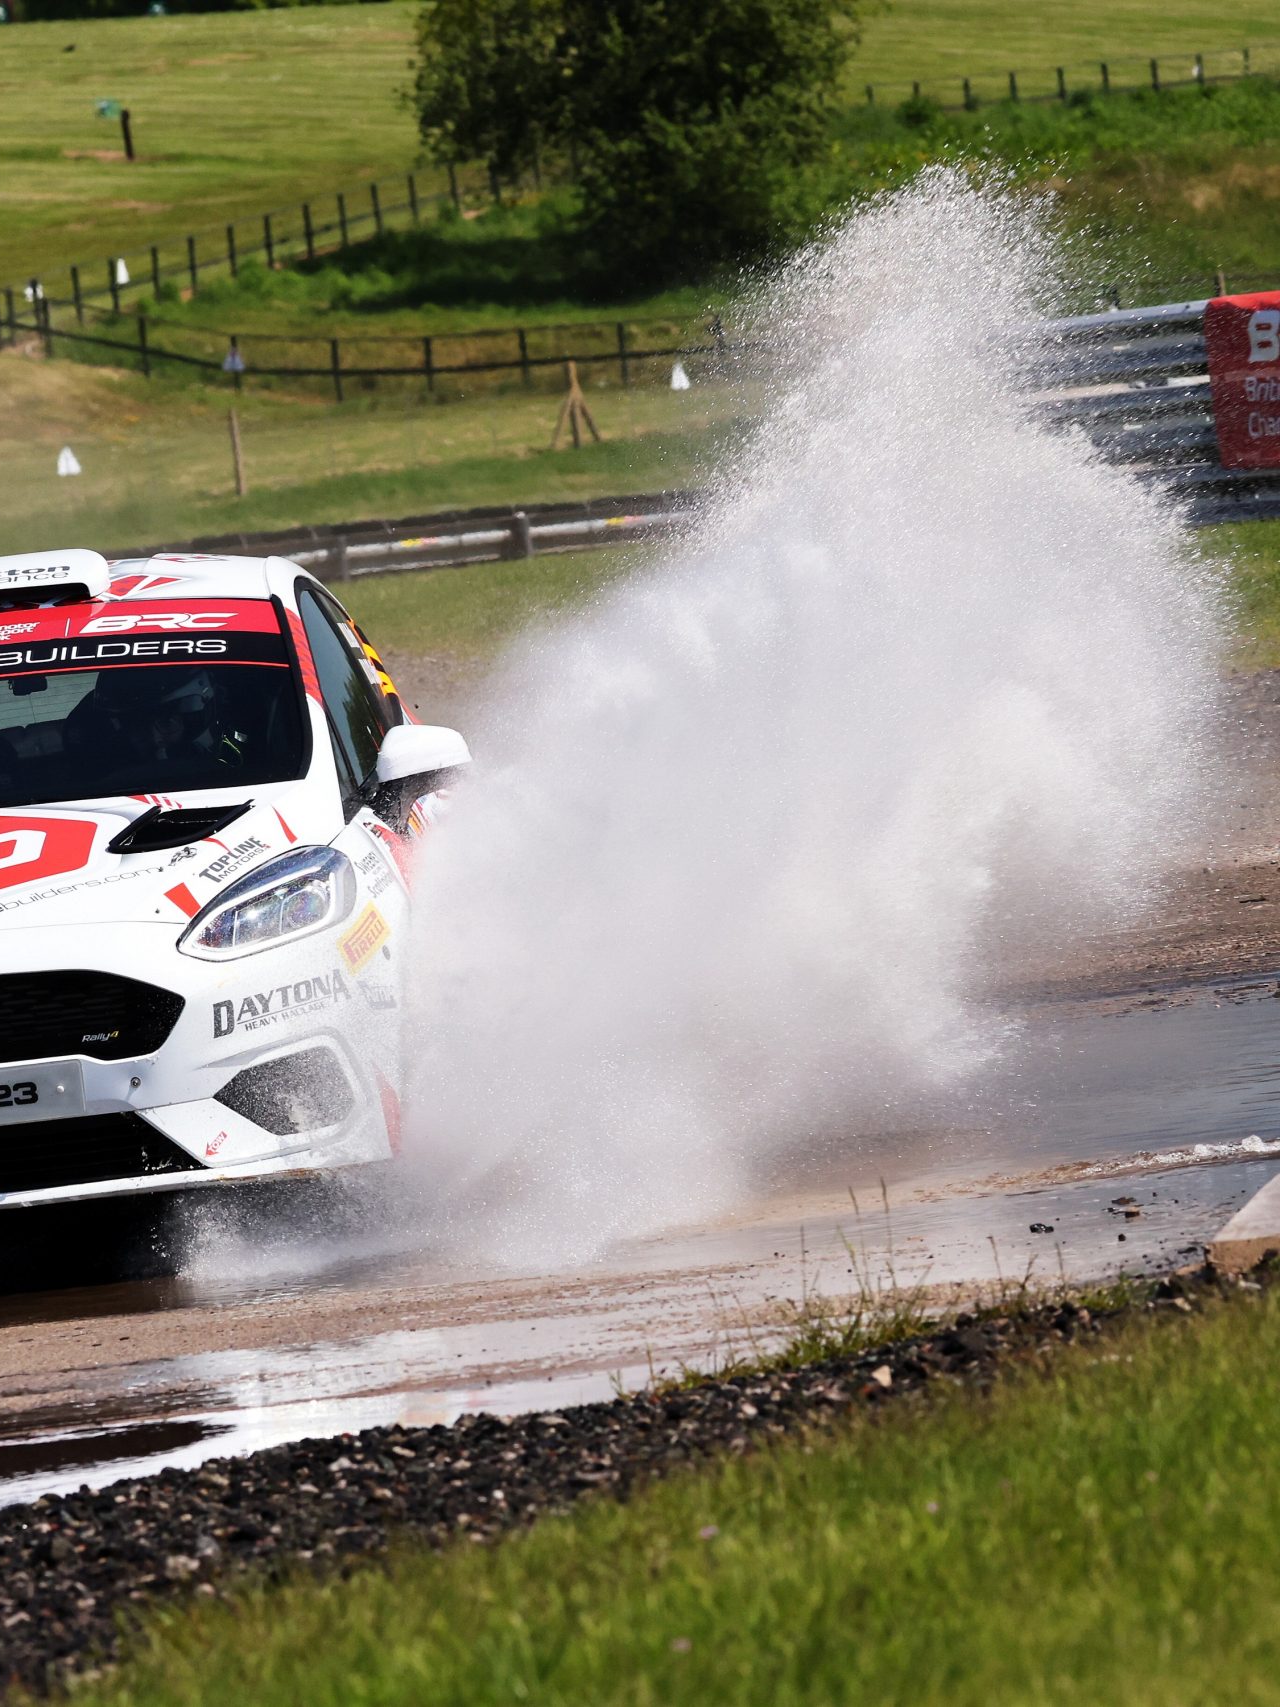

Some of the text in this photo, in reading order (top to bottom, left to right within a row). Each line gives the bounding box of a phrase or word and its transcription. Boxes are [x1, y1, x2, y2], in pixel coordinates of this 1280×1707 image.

[78, 612, 239, 635] BRC
[199, 835, 271, 883] TOPLINE
[218, 846, 264, 880] MOTORS
[342, 910, 385, 966] PIRELLI
[212, 968, 352, 1039] DAYTONA
[244, 1001, 327, 1032] HEAVY HAULAGE
[81, 1030, 119, 1043] Rally4
[209, 1130, 227, 1153] TOW
